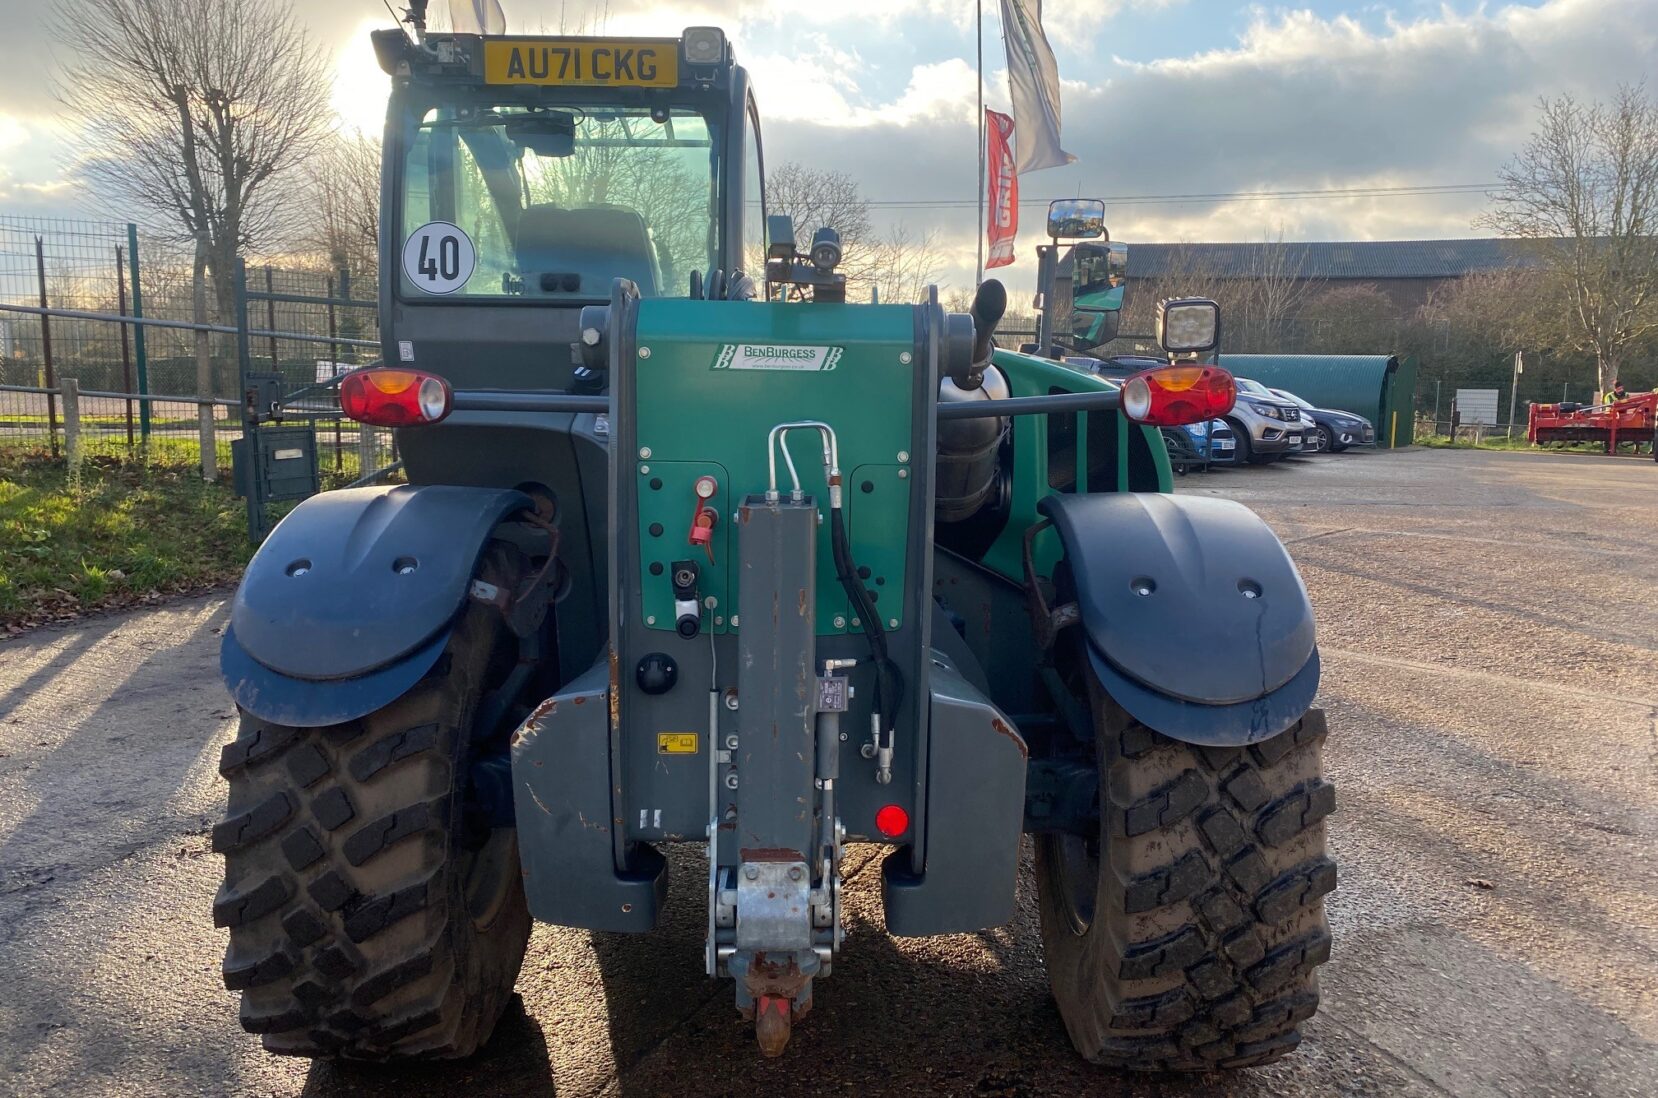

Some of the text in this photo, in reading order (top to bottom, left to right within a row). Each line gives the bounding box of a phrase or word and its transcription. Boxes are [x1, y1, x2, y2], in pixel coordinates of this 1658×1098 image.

[507, 48, 657, 81] AU71 CKG
[418, 235, 460, 281] 40
